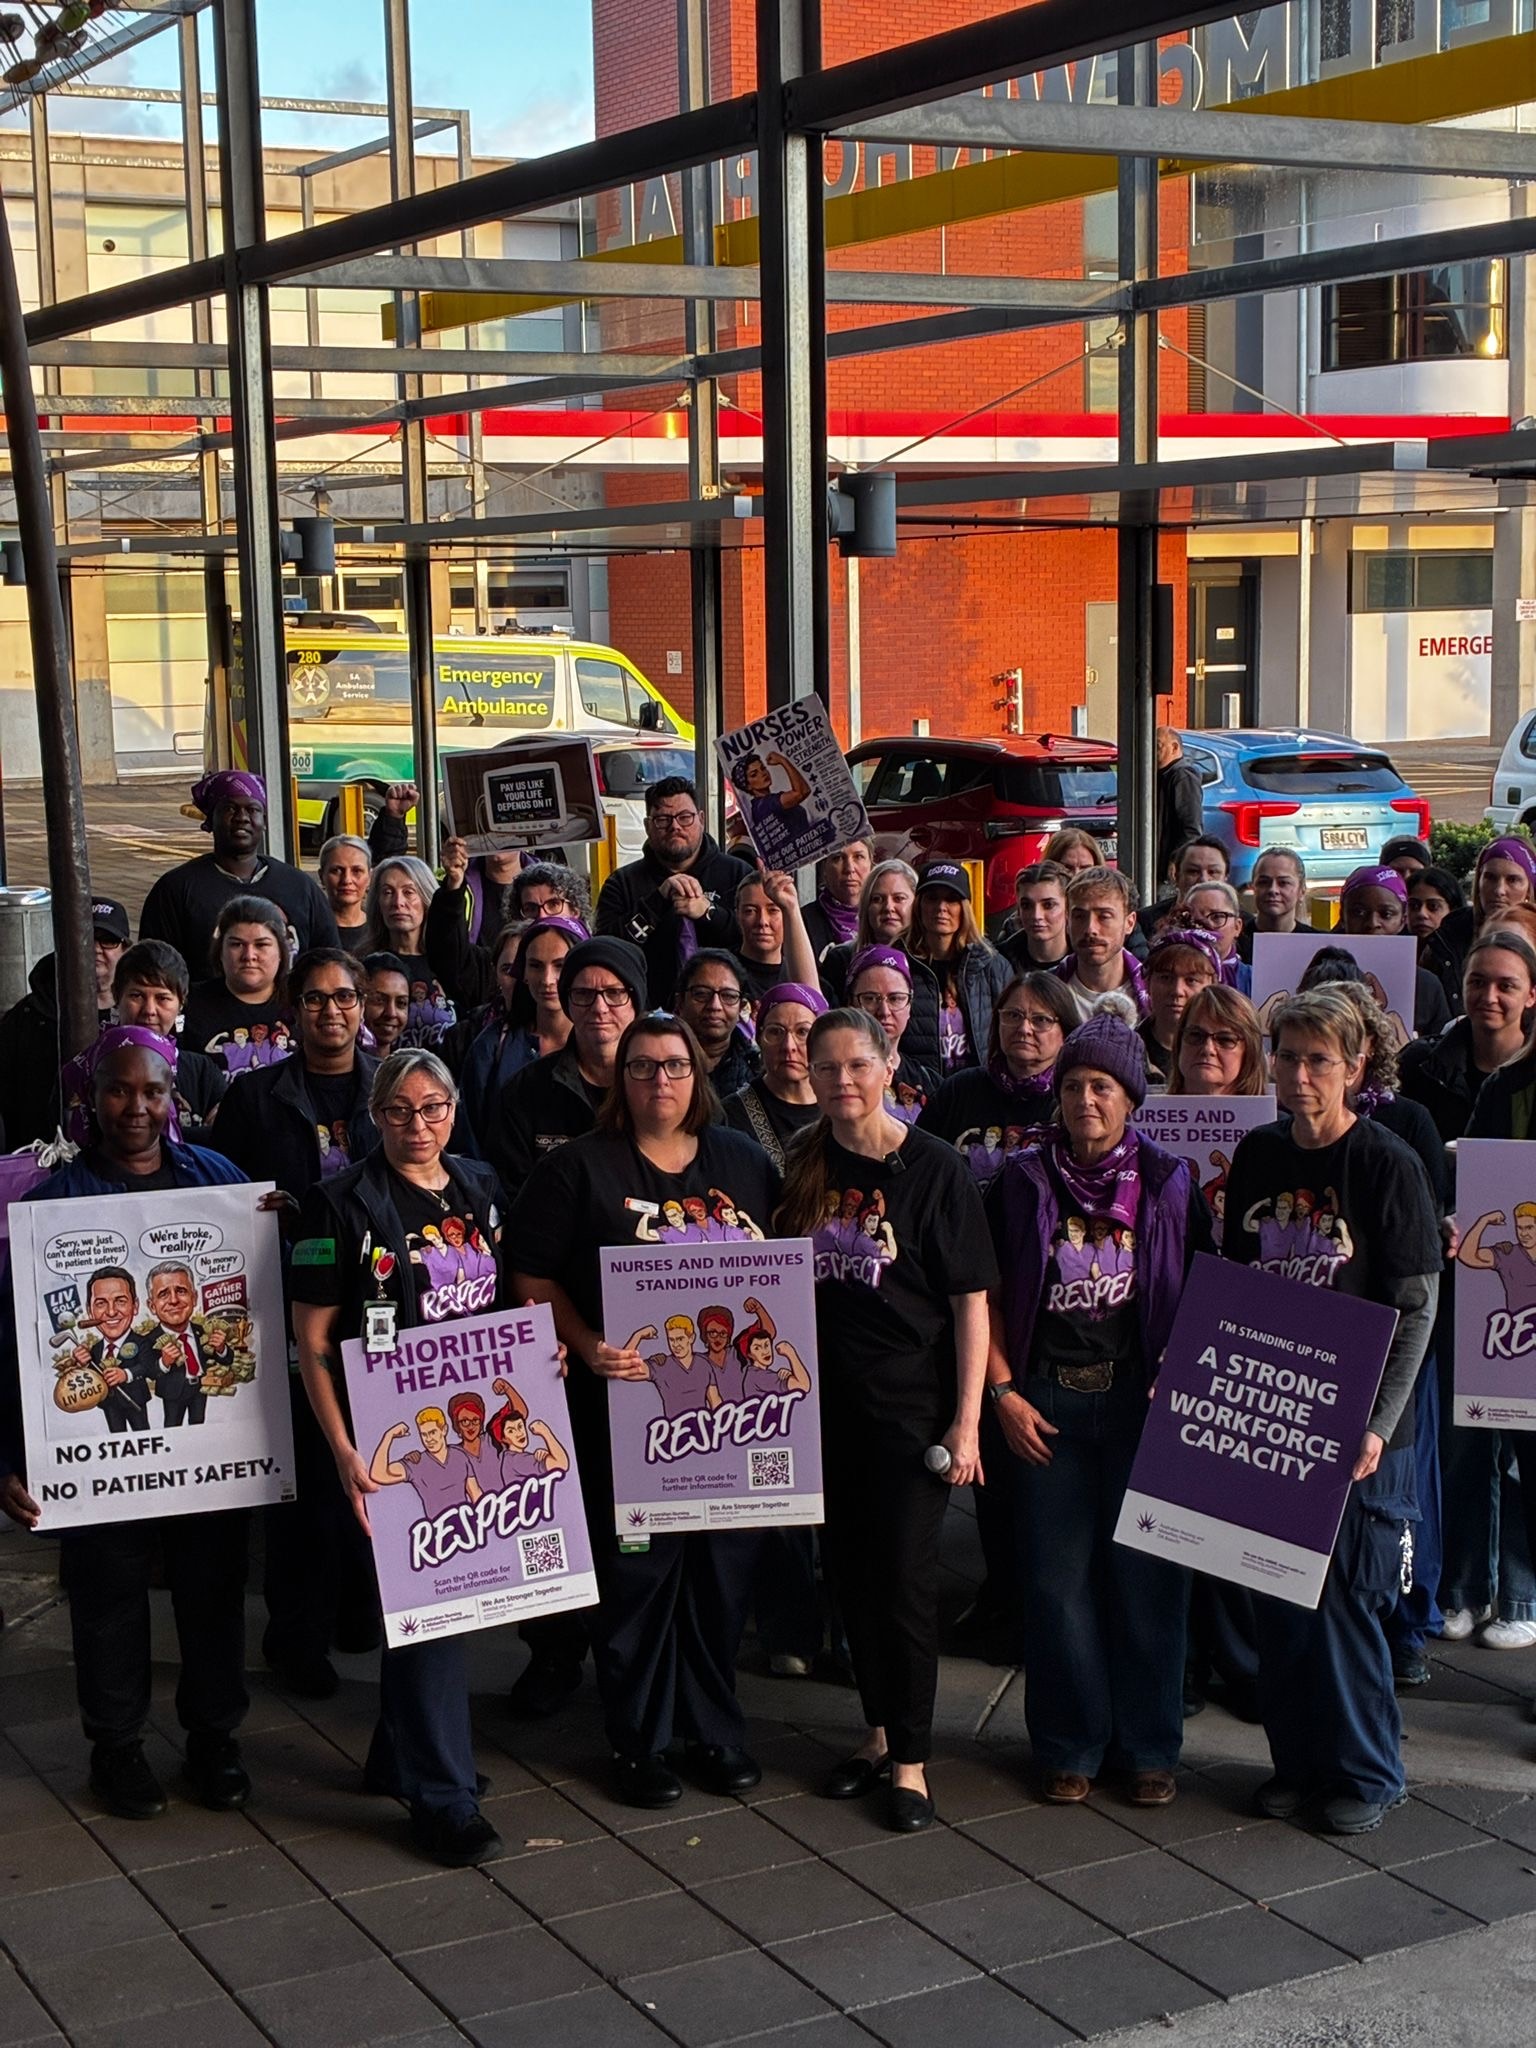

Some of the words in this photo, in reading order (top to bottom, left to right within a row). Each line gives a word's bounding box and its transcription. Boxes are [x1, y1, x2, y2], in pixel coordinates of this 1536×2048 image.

[1419, 636, 1493, 657] EMERGE
[297, 652, 321, 664] 280
[335, 682, 375, 690] Ambulance
[439, 665, 543, 689] Emergency
[442, 696, 548, 715] Ambulance
[721, 701, 809, 761] NURSES
[775, 716, 824, 751] POWER
[786, 743, 803, 757] CARE
[811, 730, 824, 741] OUR
[793, 736, 831, 765] STRENGTH
[292, 754, 311, 767] 000
[500, 782, 514, 792] PAY
[515, 781, 526, 790] US
[527, 779, 545, 790] LIKE
[504, 791, 525, 801] YOUR
[526, 789, 543, 799] LIFE
[497, 800, 531, 812] DEPENDS
[533, 799, 544, 809] ON
[545, 798, 553, 807] IT
[768, 854, 780, 865] FOR
[781, 843, 795, 856] OUR
[785, 852, 798, 863] OUR
[1126, 1109, 1188, 1124] URSES
[1194, 1110, 1236, 1124] AND
[1187, 1129, 1248, 1143] DESER
[55, 1238, 79, 1250] Sorry,
[82, 1238, 95, 1246] we
[97, 1235, 113, 1247] just
[150, 1230, 178, 1244] We're
[182, 1227, 212, 1241] broke,
[47, 1249, 66, 1260] can't
[68, 1247, 91, 1258] afford
[93, 1247, 101, 1255] to
[103, 1245, 126, 1254] invest
[160, 1239, 206, 1254] really!!
[55, 1260, 63, 1268] in
[65, 1257, 92, 1270] patient
[95, 1255, 118, 1267] safety
[200, 1257, 211, 1266] No
[213, 1255, 237, 1265] money
[208, 1264, 231, 1274] left!
[611, 1259, 672, 1273] NURSES
[679, 1257, 714, 1270] AND
[720, 1253, 803, 1269] MIDWIVES
[814, 1252, 891, 1287] ESPECT
[205, 1282, 242, 1300] GATHER
[636, 1276, 718, 1291] STANDING
[724, 1275, 744, 1288] UP
[750, 1274, 780, 1287] FOR
[1048, 1270, 1136, 1312] RESPEC
[50, 1288, 74, 1306] LIV
[208, 1292, 242, 1308] ROUND
[422, 1273, 497, 1320] RESPEC
[52, 1300, 77, 1315] GOLF
[364, 1319, 536, 1374] PRIORITISE
[1219, 1319, 1236, 1335] I'M
[1238, 1326, 1295, 1352] STANDING
[1296, 1342, 1313, 1356] UP
[1314, 1347, 1337, 1365] FOR
[66, 1372, 94, 1391] $$$
[395, 1351, 514, 1395] HEALTH
[1197, 1346, 1218, 1369] A
[1226, 1353, 1339, 1406] STRONG
[62, 1393, 78, 1407] LIV
[80, 1383, 103, 1401] GOLF
[1209, 1376, 1313, 1426] FUTURE
[648, 1392, 803, 1461] RESPECT
[1170, 1390, 1341, 1463] WORKFORCE
[56, 1444, 92, 1465] NO
[98, 1436, 171, 1461] STAFF.
[1180, 1423, 1316, 1482] CAPACITY
[42, 1482, 78, 1502] NO
[93, 1468, 188, 1497] PATIENT
[194, 1457, 281, 1485] SAFETY.
[662, 1476, 678, 1484] Scan
[680, 1475, 692, 1483] the
[694, 1475, 706, 1483] QR
[707, 1474, 725, 1482] code
[726, 1473, 738, 1482] for
[662, 1483, 688, 1492] further
[690, 1481, 736, 1490] information.
[709, 1504, 720, 1512] We
[734, 1502, 761, 1512] Stronger
[762, 1501, 790, 1510] Together
[412, 1470, 563, 1569] RESPECT
[434, 1576, 451, 1588] Scan
[453, 1573, 465, 1584] the
[467, 1571, 479, 1582] QR
[480, 1568, 498, 1579] code
[499, 1565, 511, 1575] for
[434, 1584, 462, 1596] further
[463, 1574, 509, 1590] information.
[481, 1598, 493, 1607] We
[494, 1596, 505, 1605] Are
[506, 1591, 534, 1604] Stronger
[535, 1585, 562, 1599] Together
